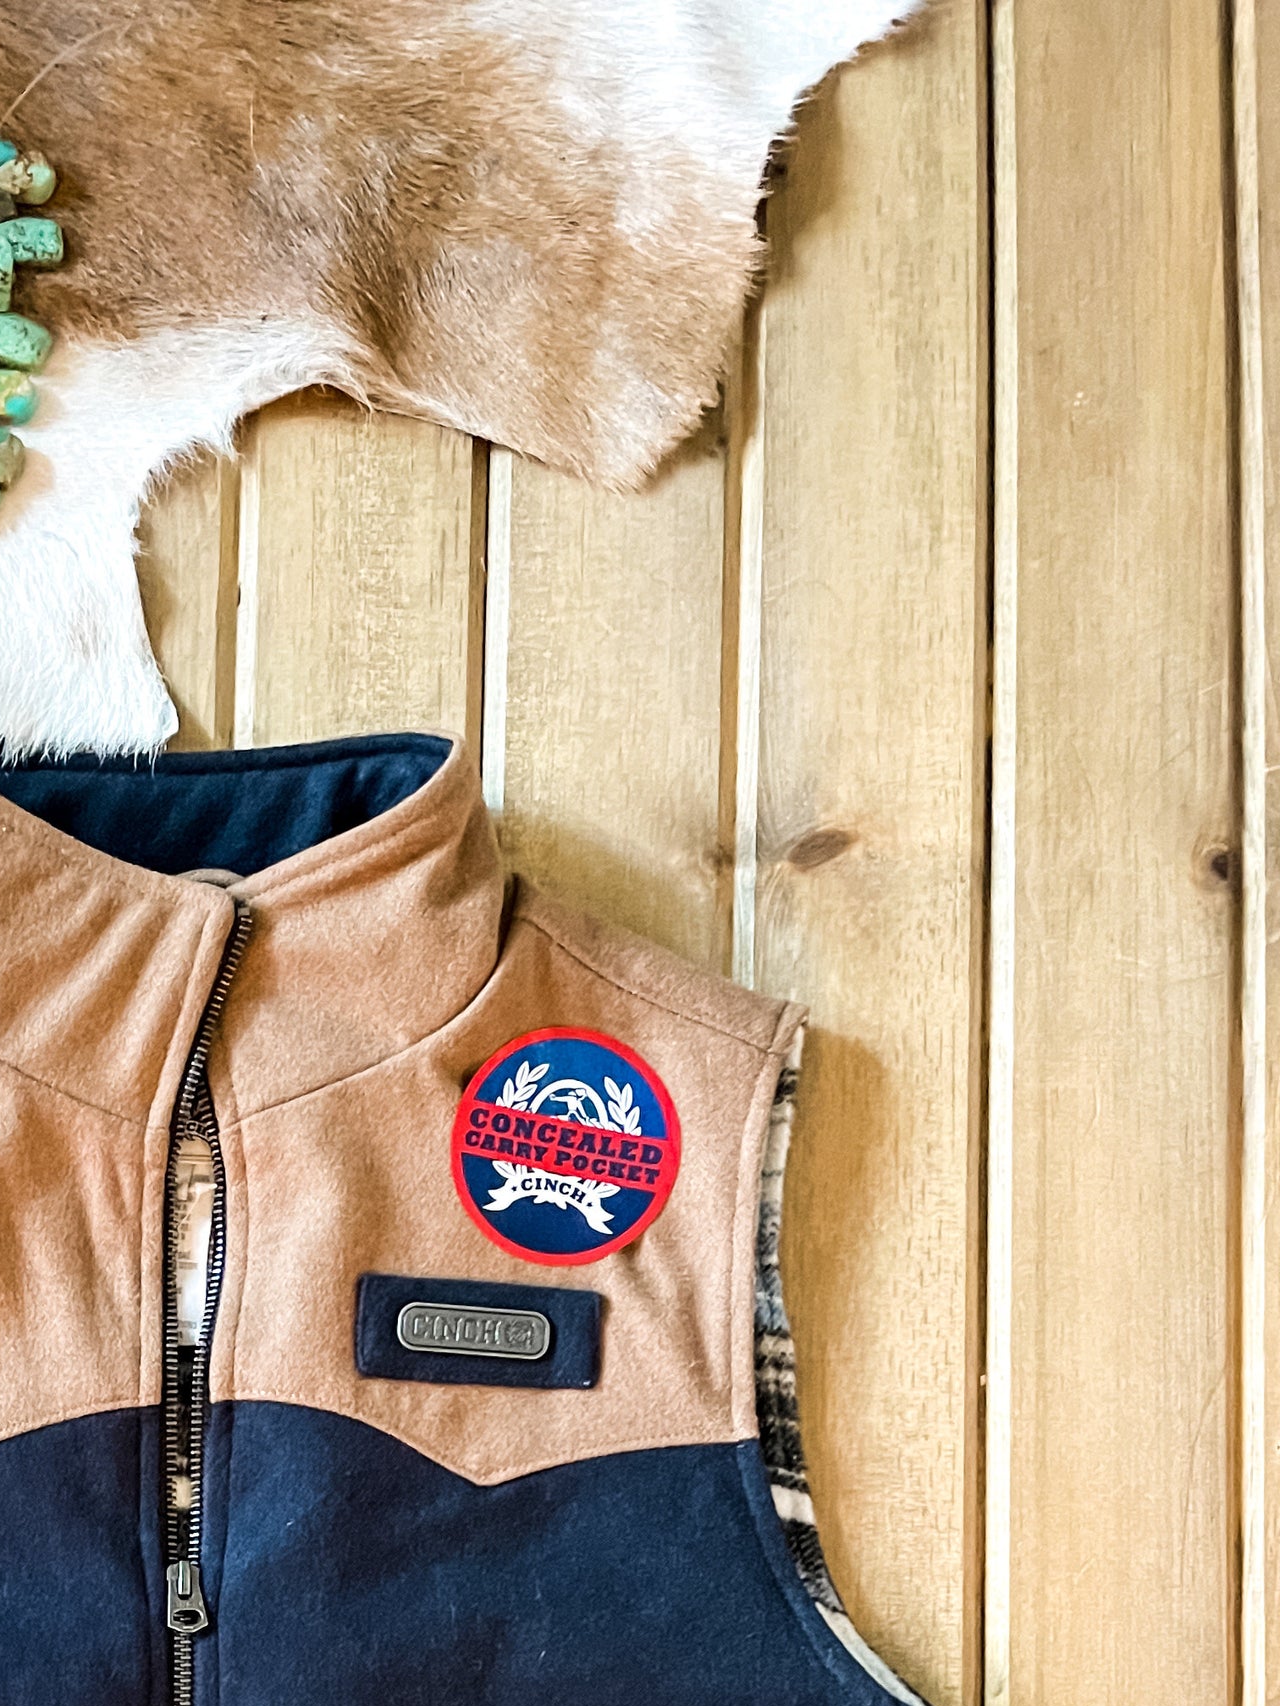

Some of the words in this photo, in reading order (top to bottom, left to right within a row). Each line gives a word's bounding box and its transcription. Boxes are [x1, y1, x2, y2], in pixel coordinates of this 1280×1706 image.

[465, 1131, 547, 1166] CARRY
[554, 1151, 660, 1185] POCKET
[470, 1108, 663, 1165] CONCEALED
[521, 1178, 586, 1203] CINCH
[413, 1314, 503, 1346] CINCH
